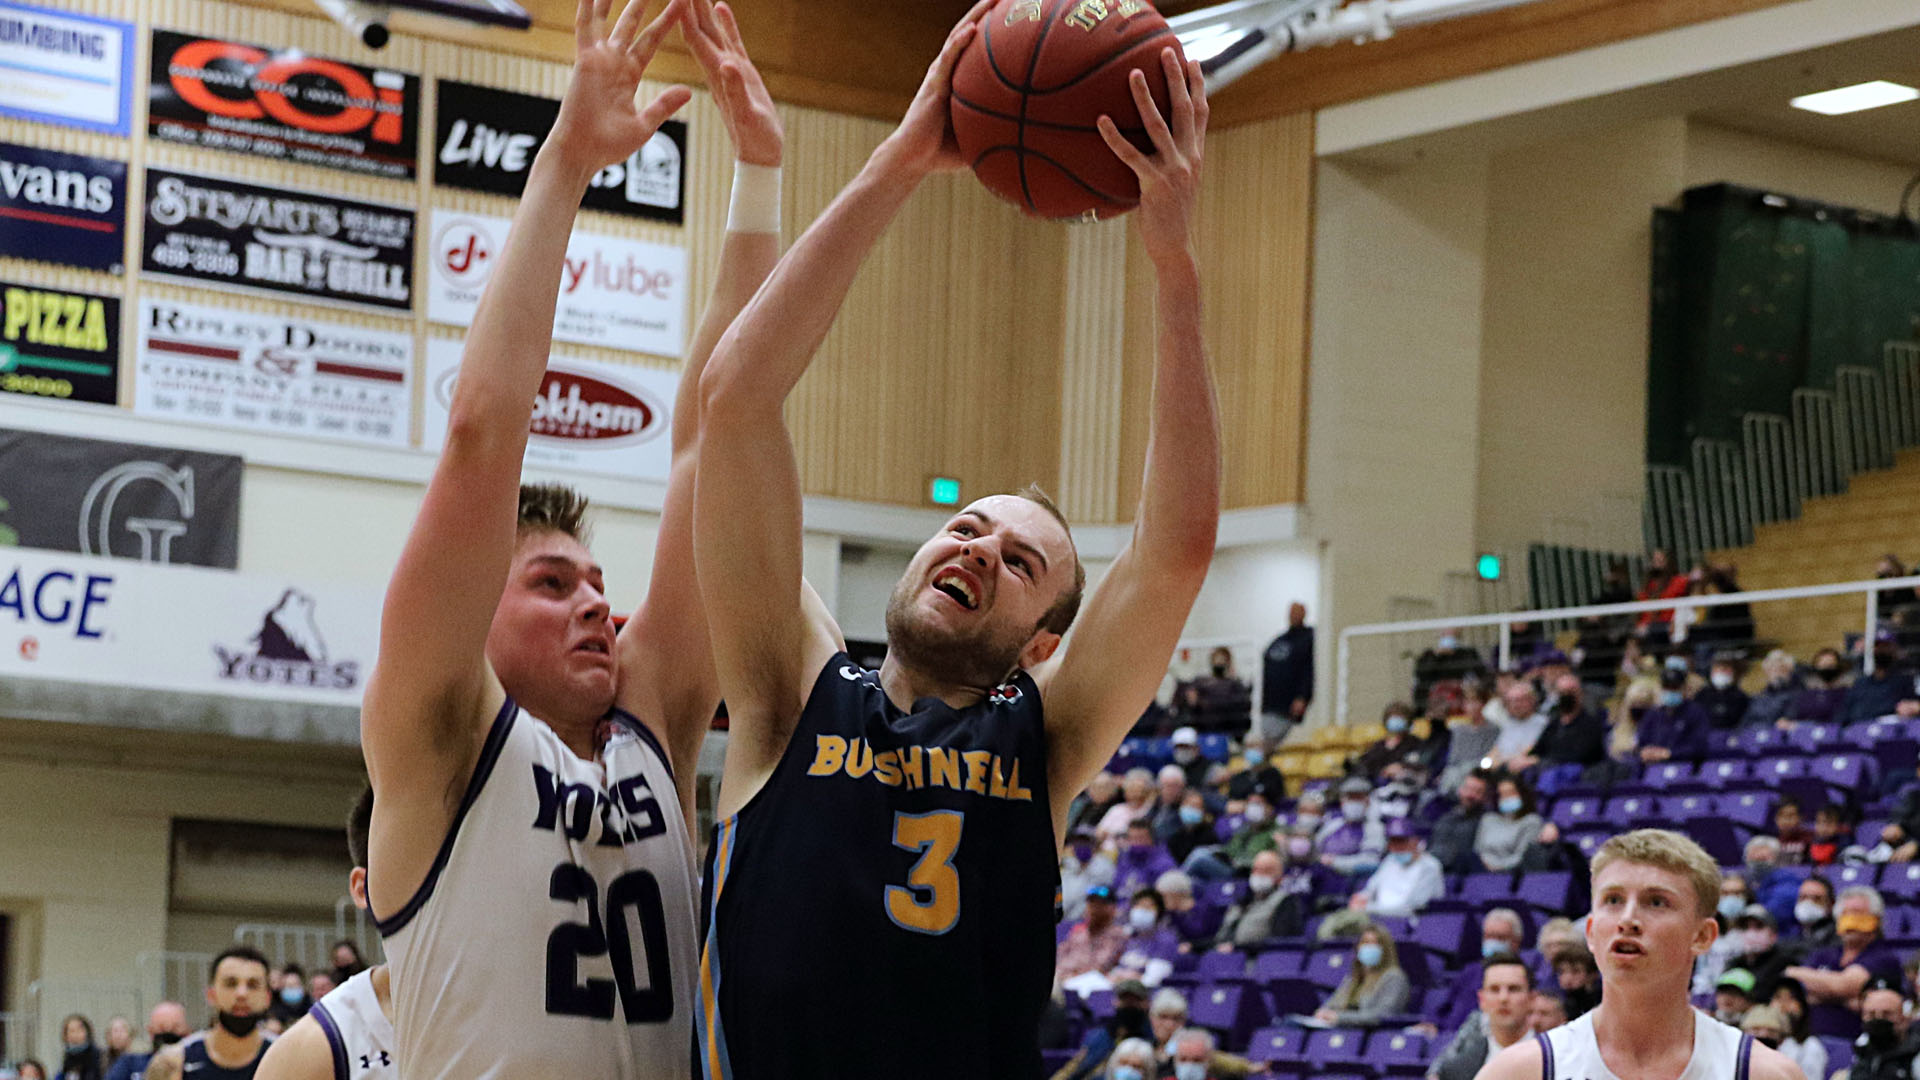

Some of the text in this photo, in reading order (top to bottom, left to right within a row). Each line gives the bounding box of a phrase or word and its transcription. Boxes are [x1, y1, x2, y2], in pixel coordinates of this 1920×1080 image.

[0, 160, 114, 214] vans
[327, 256, 410, 302] GRILL
[593, 251, 674, 300] lube
[4, 287, 109, 352] PIZZA
[0, 566, 117, 640] AGE
[214, 644, 359, 689] YOTES
[806, 733, 1033, 802] BUSHNELL
[884, 809, 965, 936] 3
[545, 862, 675, 1025] 20
